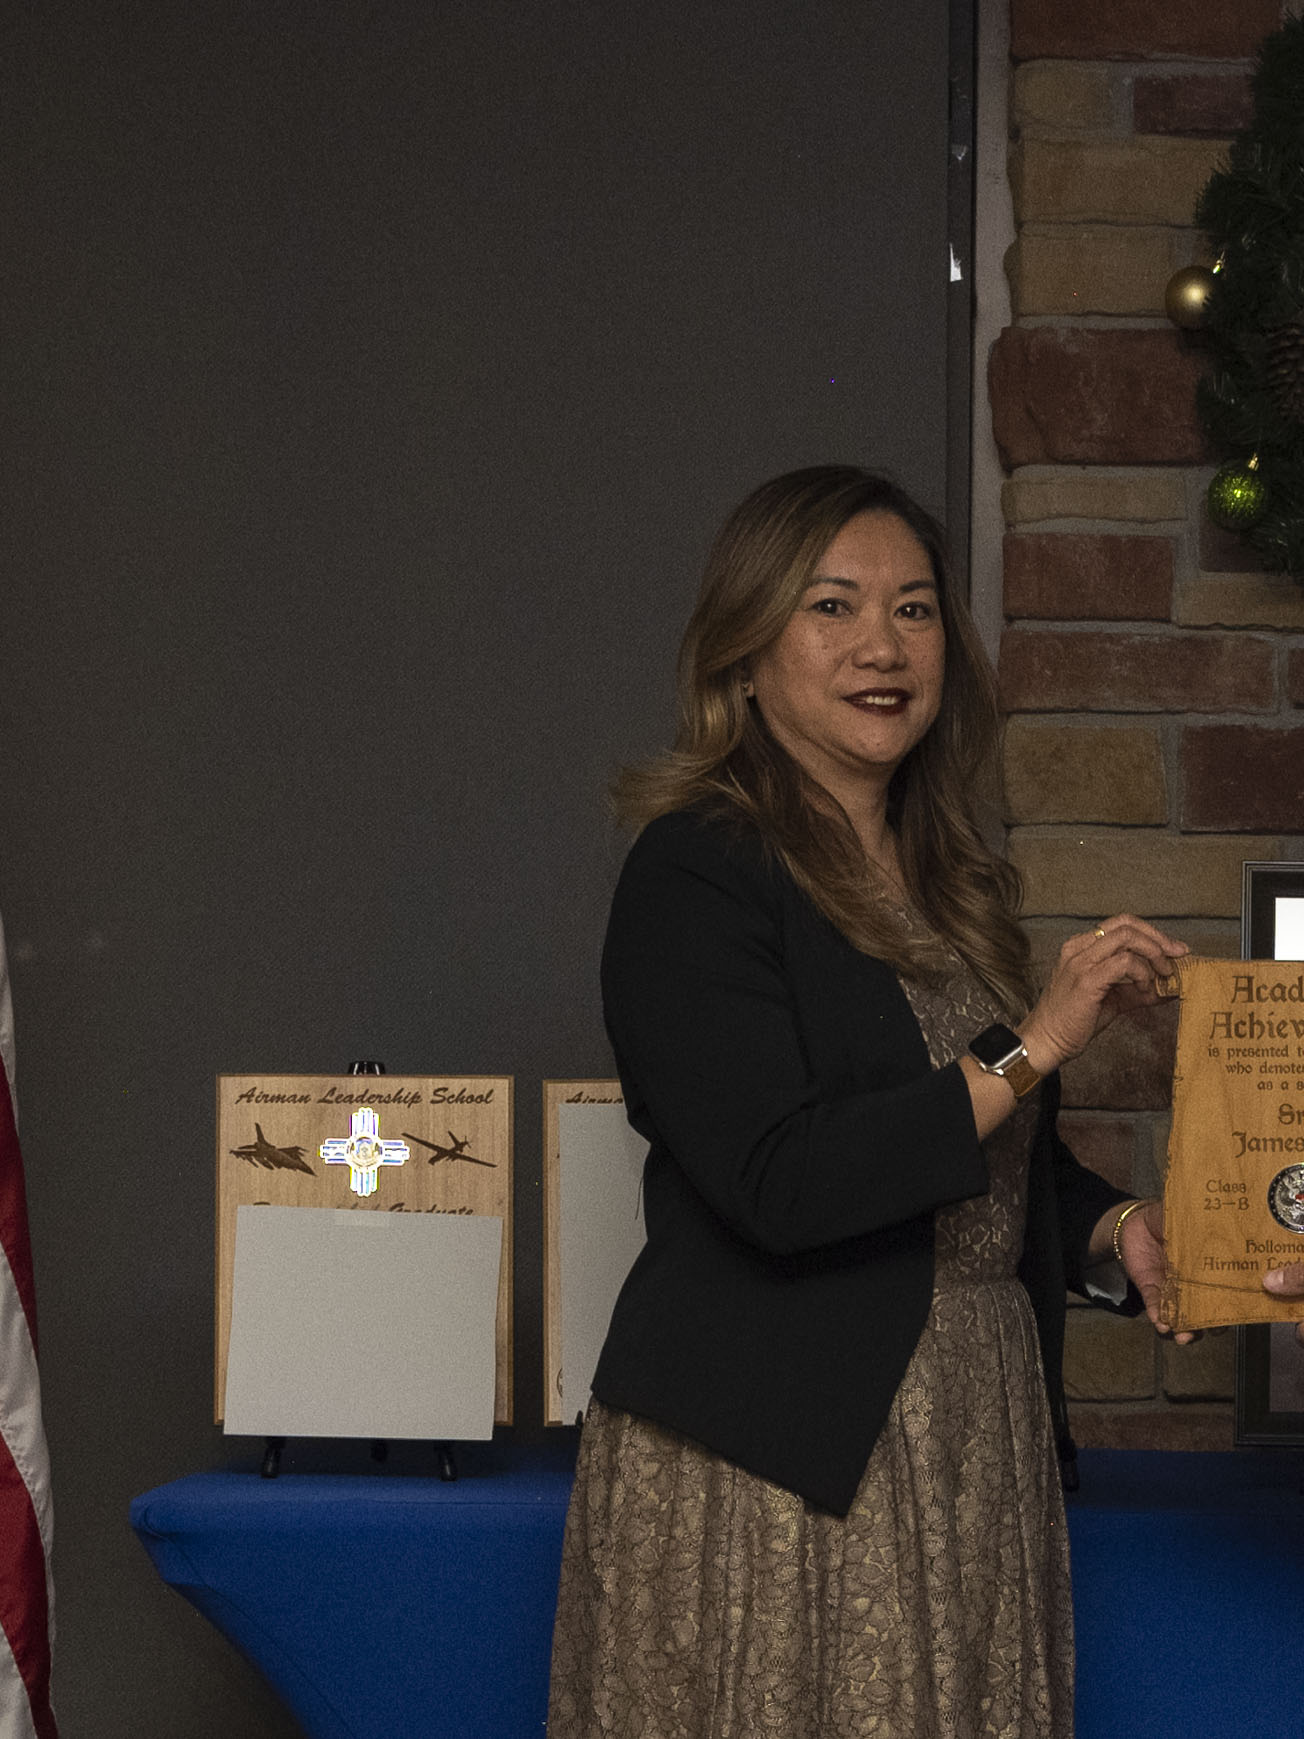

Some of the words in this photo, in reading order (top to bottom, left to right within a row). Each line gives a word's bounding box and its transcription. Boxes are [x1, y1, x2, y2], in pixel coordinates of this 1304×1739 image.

[1208, 1046, 1220, 1058] is
[1227, 1045, 1289, 1060] presented
[1225, 1062, 1252, 1074] who
[1257, 1081, 1273, 1091] as
[1280, 1081, 1289, 1091] a
[235, 1087, 311, 1104] Airman
[316, 1087, 422, 1108] Leadership
[430, 1087, 494, 1104] School
[1206, 1179, 1246, 1193] Class
[1203, 1256, 1259, 1271] Airman
